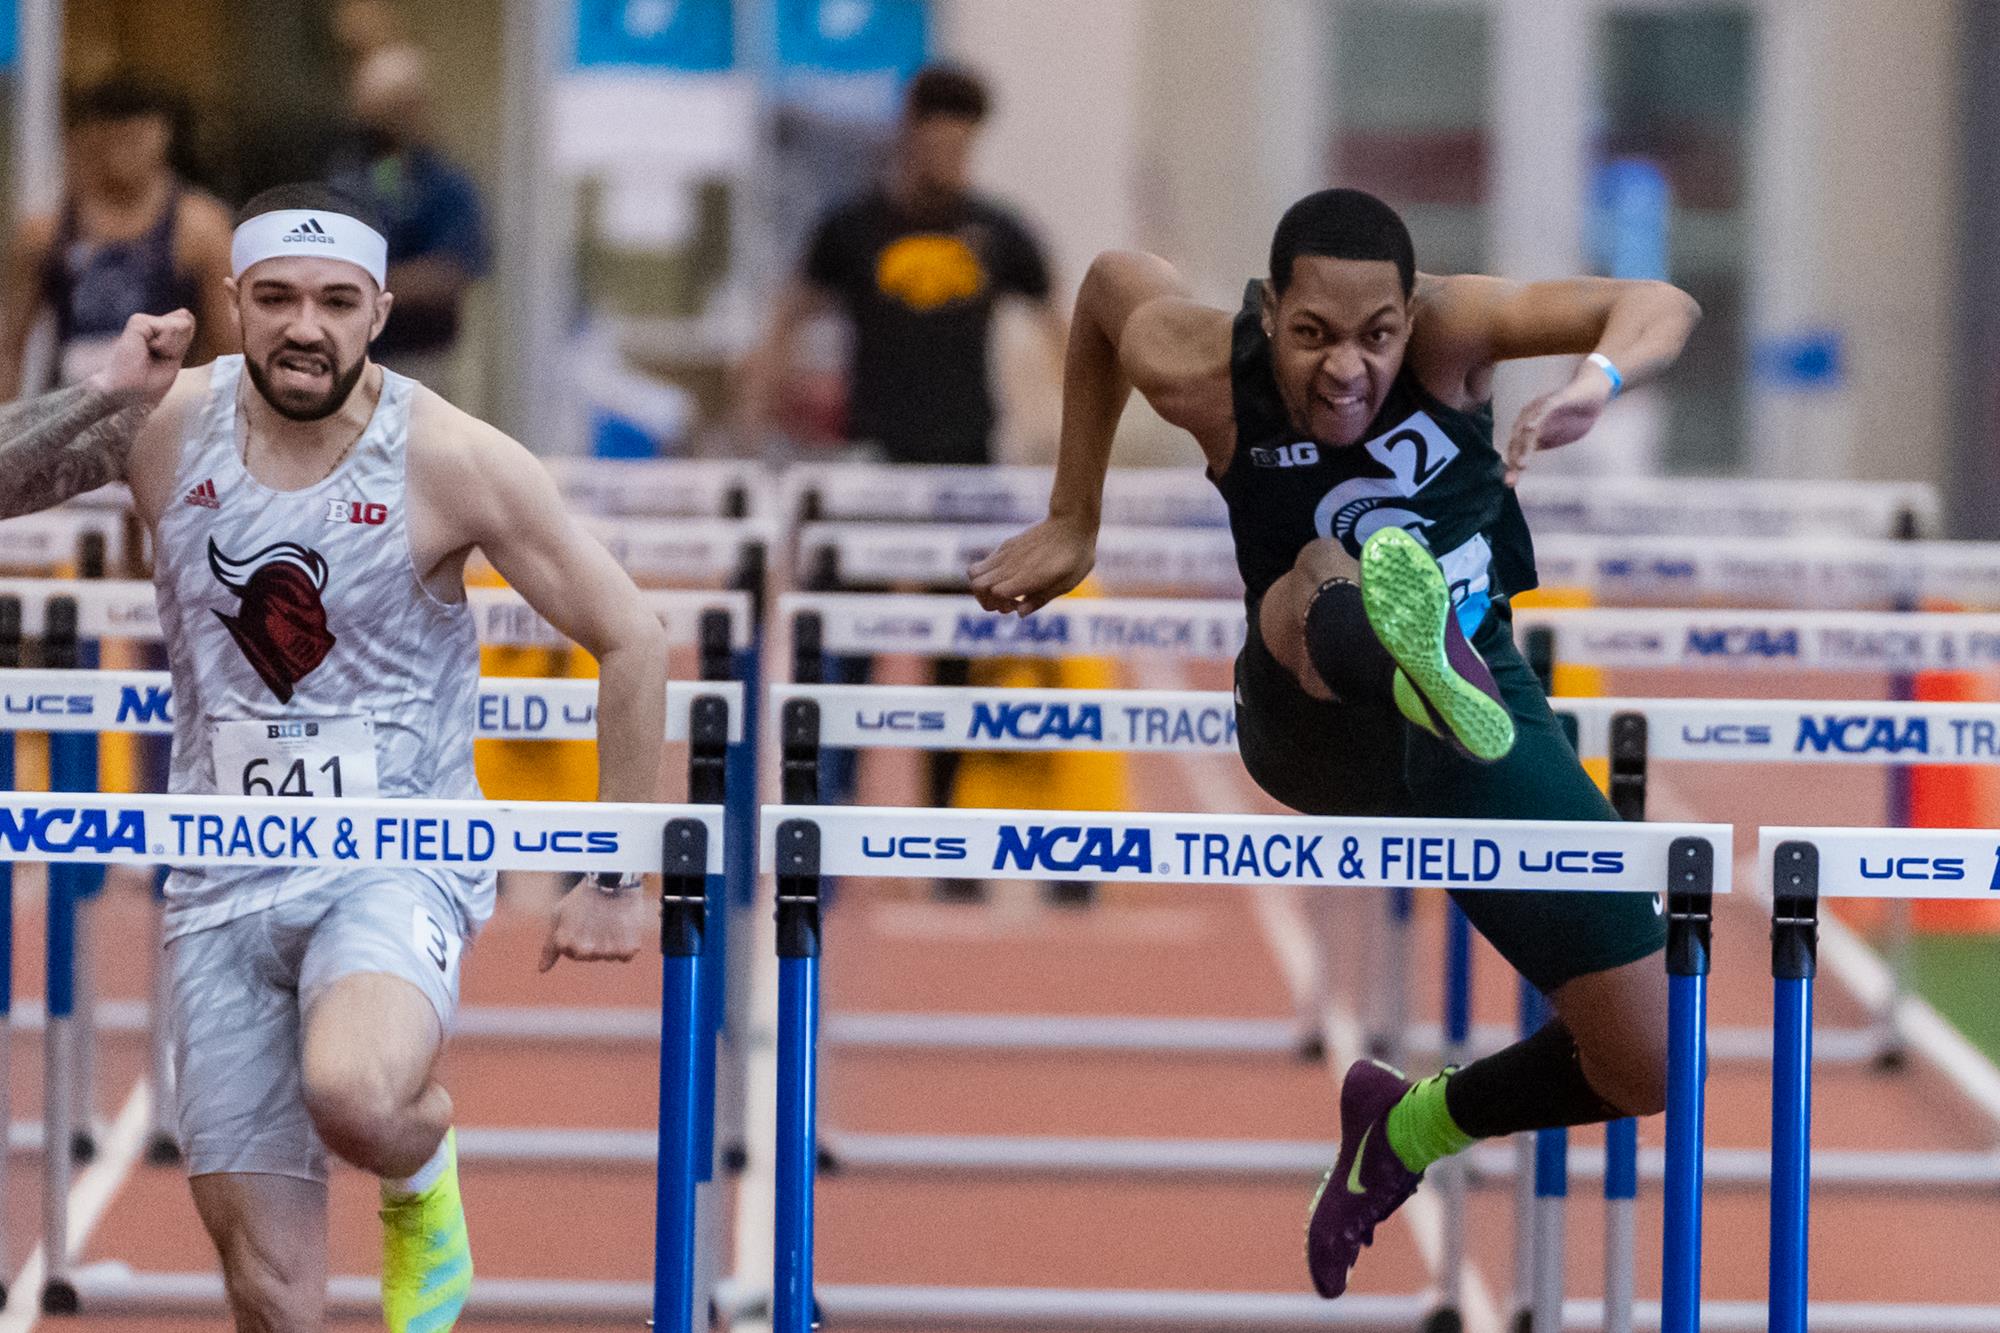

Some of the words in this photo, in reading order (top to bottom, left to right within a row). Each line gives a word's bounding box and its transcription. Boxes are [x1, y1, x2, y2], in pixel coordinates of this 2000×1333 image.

[282, 234, 336, 244] adidas
[1384, 429, 1448, 486] 2
[4, 694, 94, 714] UCS
[855, 710, 946, 730] UCS
[969, 703, 1103, 741] NCAA
[1682, 725, 1772, 745] UCS
[1794, 716, 1929, 754] NCAA
[1949, 719, 2000, 756] TR
[242, 756, 342, 797] 641
[0, 808, 146, 854] NCAA
[169, 813, 319, 858] TRACK
[332, 817, 360, 860] &
[374, 817, 496, 862] FIELD
[513, 830, 620, 854] UCS
[862, 836, 967, 859] UCS
[992, 825, 1152, 874] NCAA
[1176, 833, 1323, 878] TRACK
[1338, 836, 1364, 879] &
[1380, 837, 1500, 882] FIELD
[1518, 850, 1624, 874] UCS
[1859, 857, 1965, 881] UCS
[427, 915, 447, 972] 3
